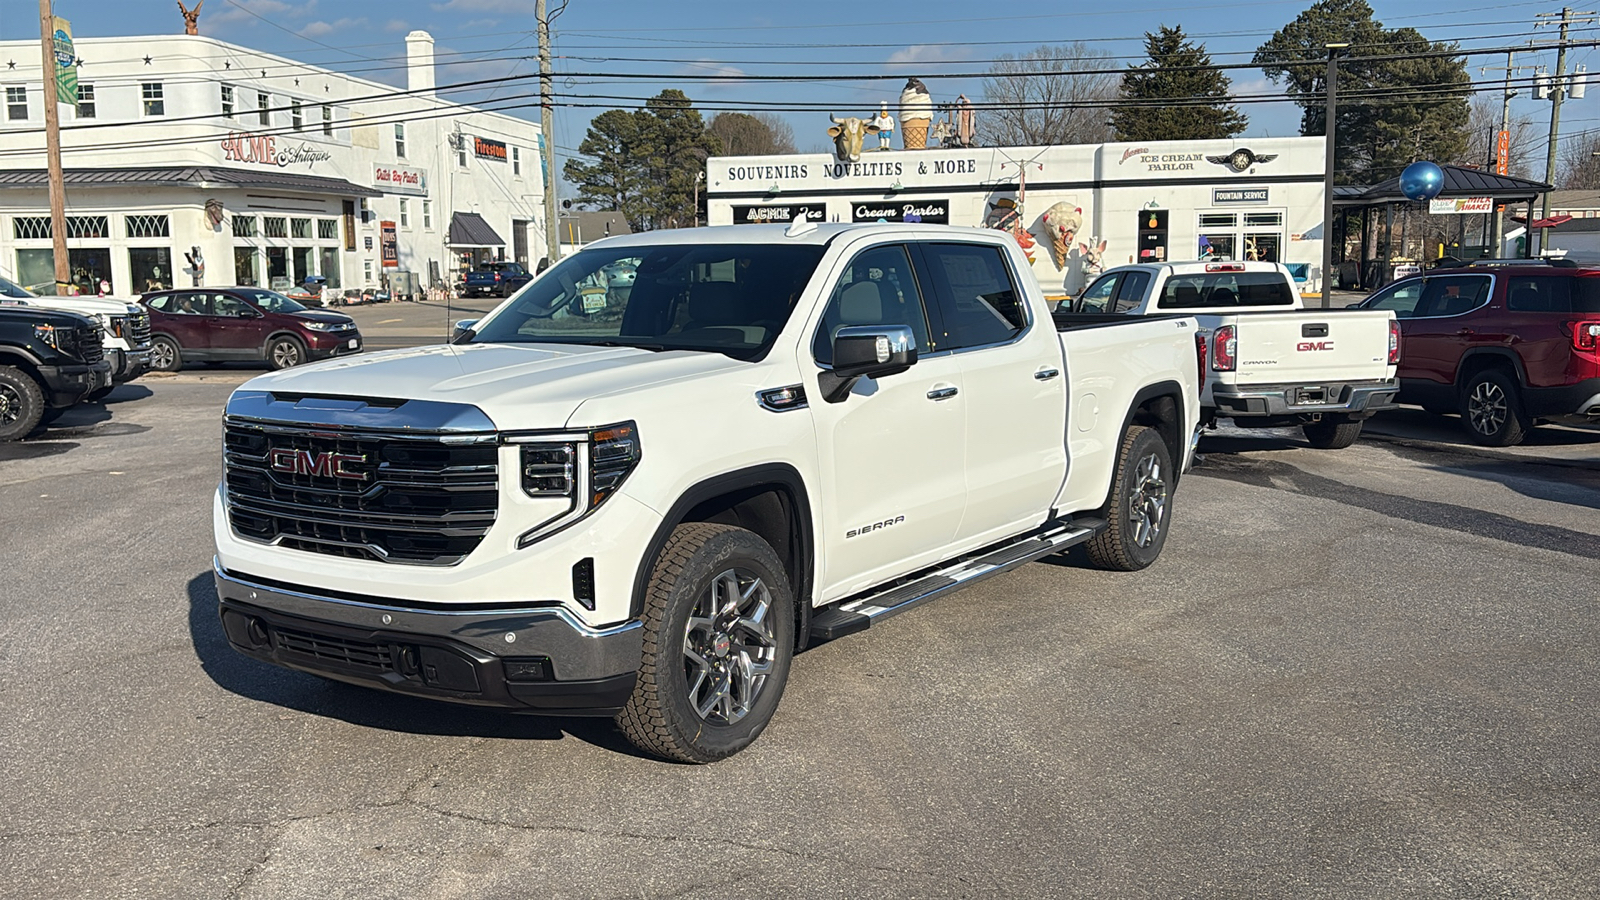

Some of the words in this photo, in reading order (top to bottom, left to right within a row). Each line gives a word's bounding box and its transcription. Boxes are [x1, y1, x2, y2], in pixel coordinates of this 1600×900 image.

[221, 131, 277, 165] ACME
[277, 142, 331, 169] Antiques
[475, 137, 507, 158] Firestone
[1140, 155, 1159, 163] ICE
[1161, 153, 1203, 162] CREAM
[728, 164, 808, 181] SOUVENIRS
[823, 162, 903, 178] NOVELTIES
[917, 161, 928, 175] &
[934, 159, 976, 174] MORE
[1147, 163, 1194, 171] PARLOR
[376, 168, 391, 181] Dutch
[392, 170, 403, 185] Boy
[403, 171, 419, 184] Paints
[1216, 191, 1243, 200] FOUNTAIN
[1243, 190, 1267, 200] SERVICE
[747, 207, 790, 220] ACME
[855, 205, 897, 218] Cream
[902, 204, 945, 217] Parlor
[1460, 203, 1491, 211] SHAKES
[1296, 341, 1334, 352] GMC
[269, 447, 369, 480] GMC
[845, 515, 905, 539] SIERRA
